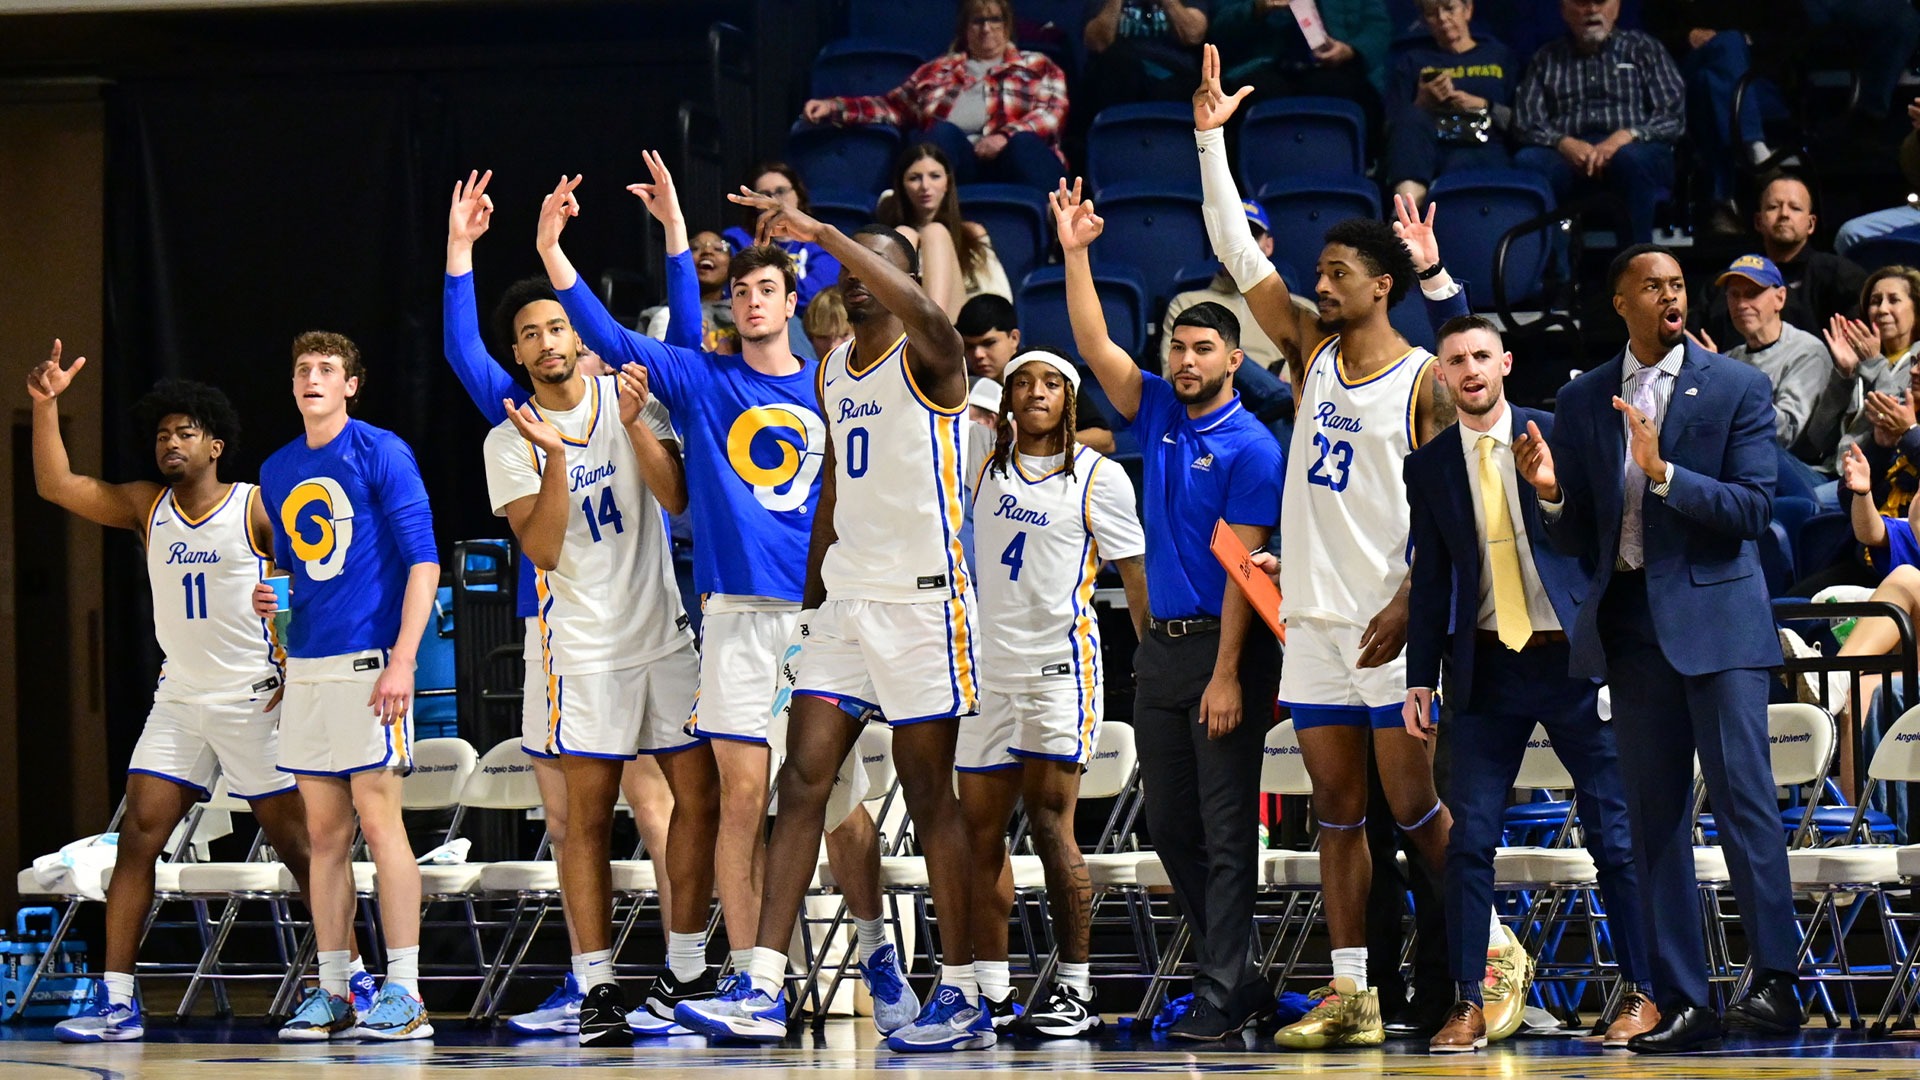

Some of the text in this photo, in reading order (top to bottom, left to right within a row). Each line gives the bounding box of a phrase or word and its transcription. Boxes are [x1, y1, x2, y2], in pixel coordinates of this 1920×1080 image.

[837, 397, 882, 424] Rams
[1313, 401, 1363, 433] Rams
[847, 426, 869, 479] 0
[1307, 432, 1354, 493] 23
[570, 460, 616, 492] Rams
[581, 486, 624, 543] 14
[993, 494, 1050, 527] Rams
[166, 541, 221, 564] Rams
[1000, 531, 1027, 581] 4
[182, 572, 207, 619] 11
[418, 765, 433, 773] State
[482, 765, 507, 774] Angelo
[508, 764, 524, 772] State
